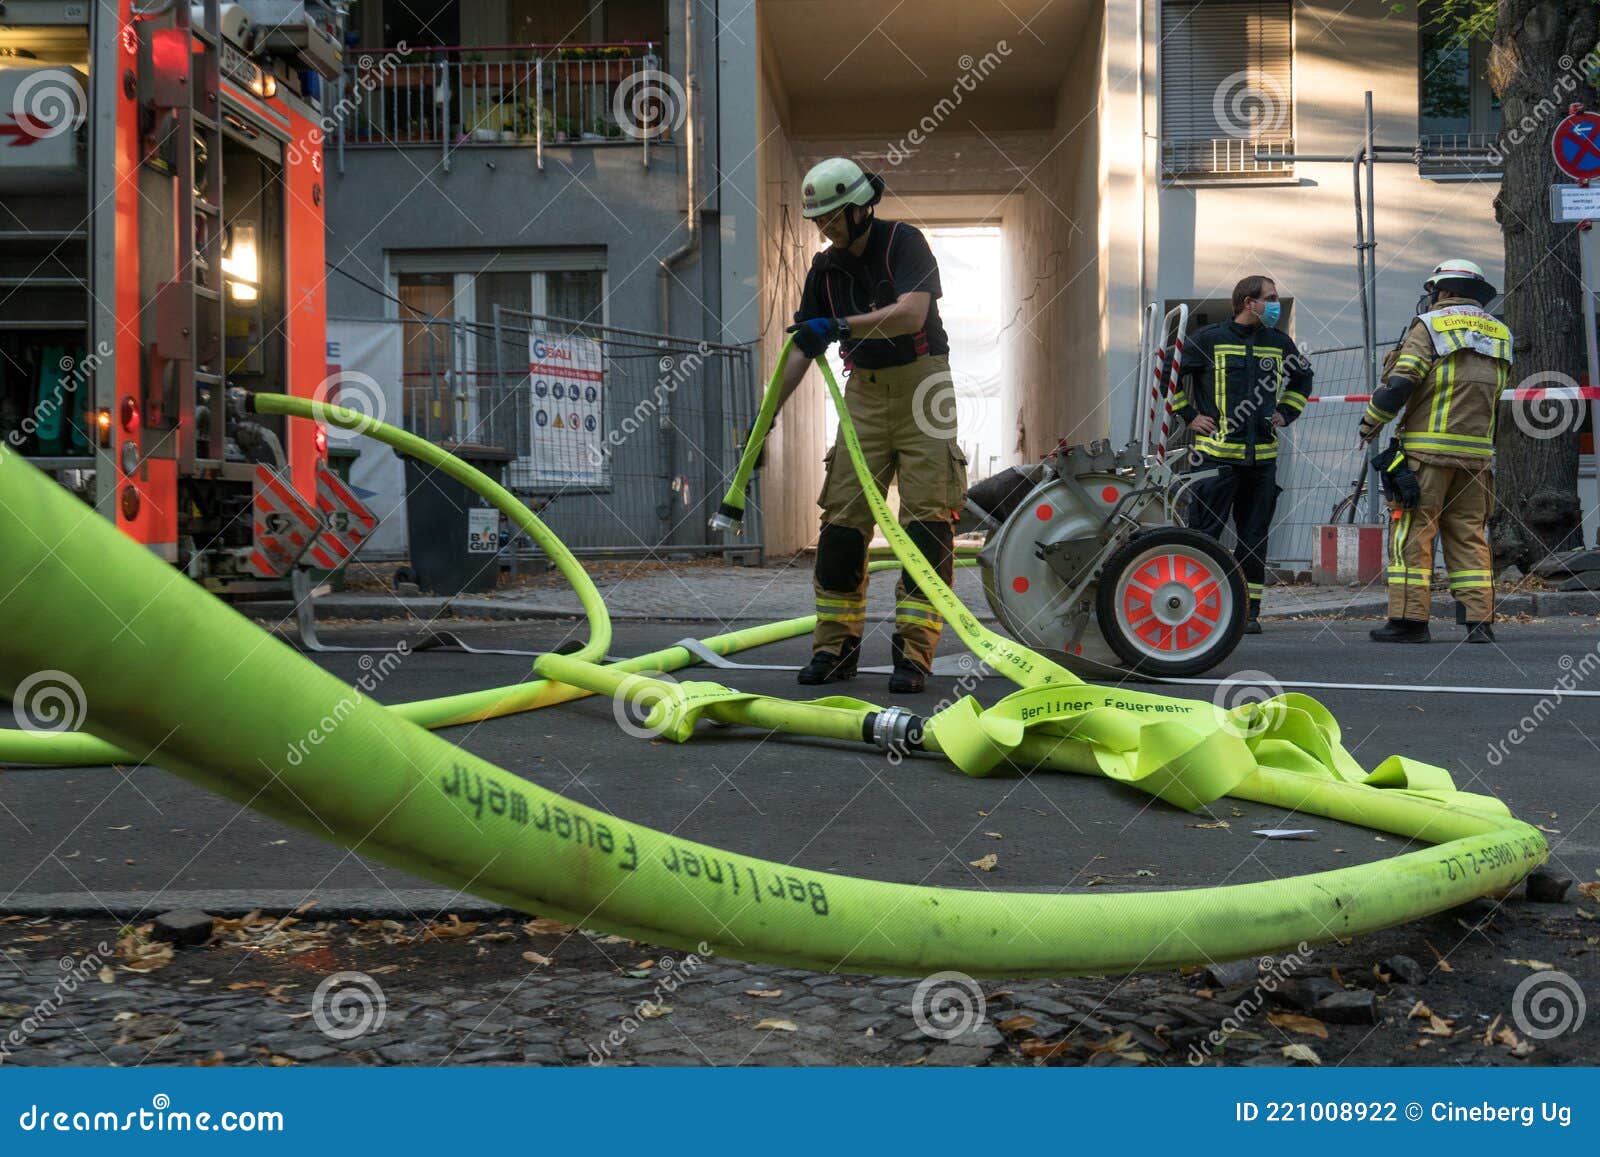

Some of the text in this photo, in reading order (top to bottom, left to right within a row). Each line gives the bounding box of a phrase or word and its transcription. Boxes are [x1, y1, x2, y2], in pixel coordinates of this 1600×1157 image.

[470, 541, 497, 551] GUT
[1021, 698, 1193, 720] Berliner Feuerwehr
[441, 761, 829, 918] Berliner Feuerwehr
